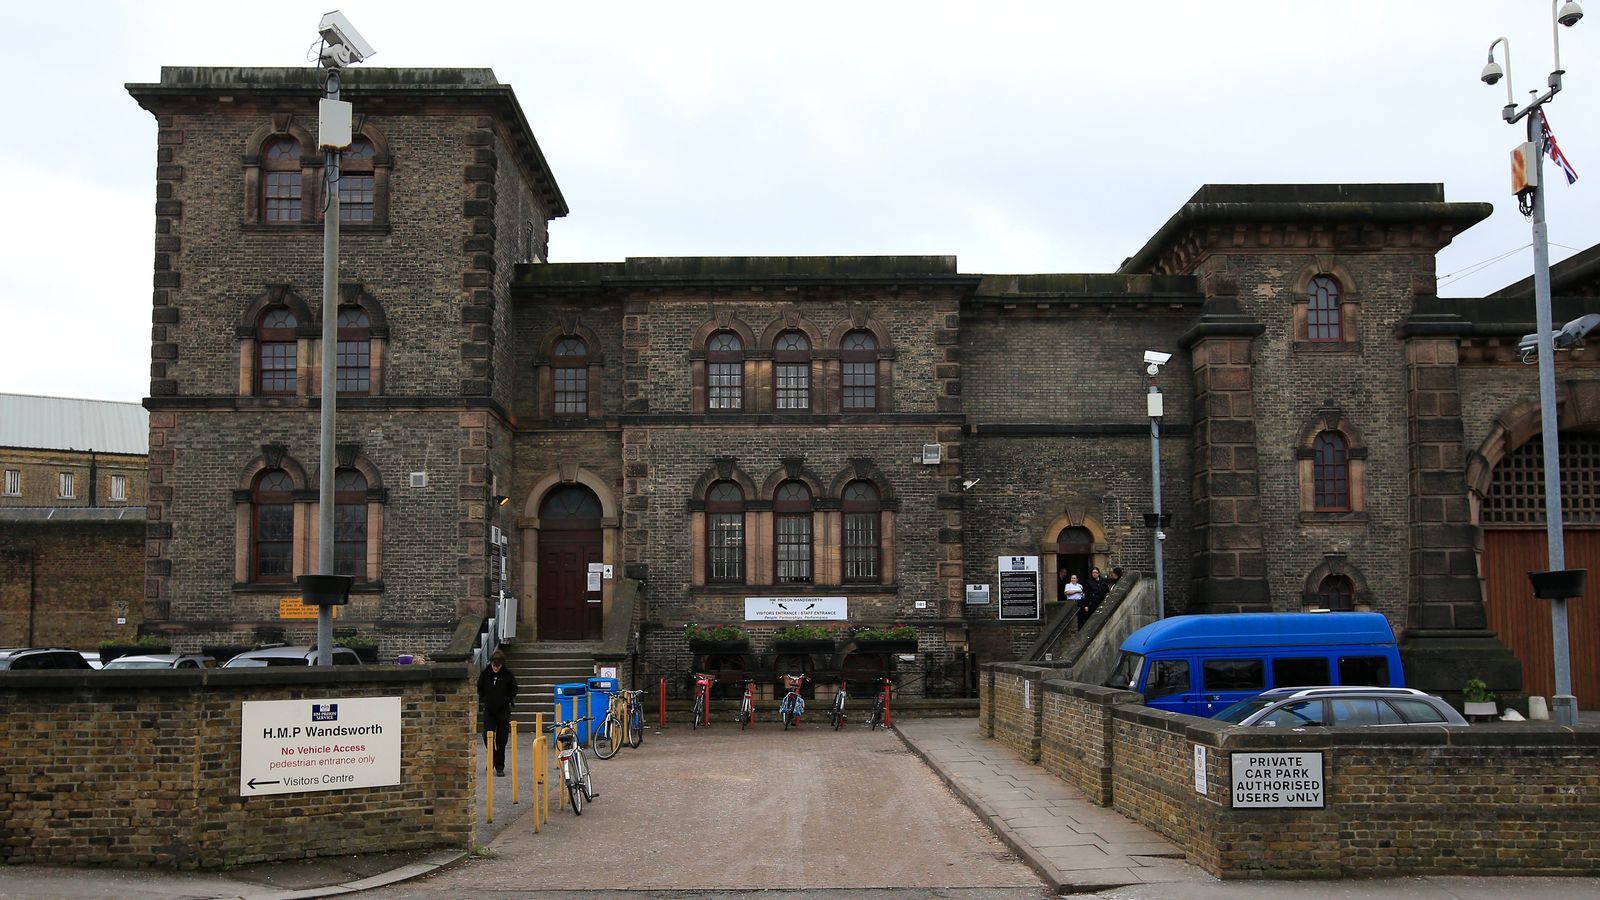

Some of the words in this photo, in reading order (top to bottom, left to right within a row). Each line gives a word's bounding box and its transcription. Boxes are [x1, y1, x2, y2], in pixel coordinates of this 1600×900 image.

[263, 727, 301, 739] H.M.P
[305, 724, 383, 737] Wandsworth
[281, 747, 295, 756] No
[297, 745, 331, 755] Vehicle
[333, 744, 366, 753] Access
[269, 758, 316, 770] pedestrian
[318, 756, 356, 766] entrance
[358, 755, 376, 765] only
[1249, 757, 1302, 767] PRIVATE
[1245, 769, 1272, 779] CAR
[1275, 769, 1309, 778] PARK
[283, 775, 319, 787] Visitors
[322, 773, 354, 784] Centre
[1236, 781, 1320, 791] AUTHORISED
[1236, 793, 1280, 803] USERS
